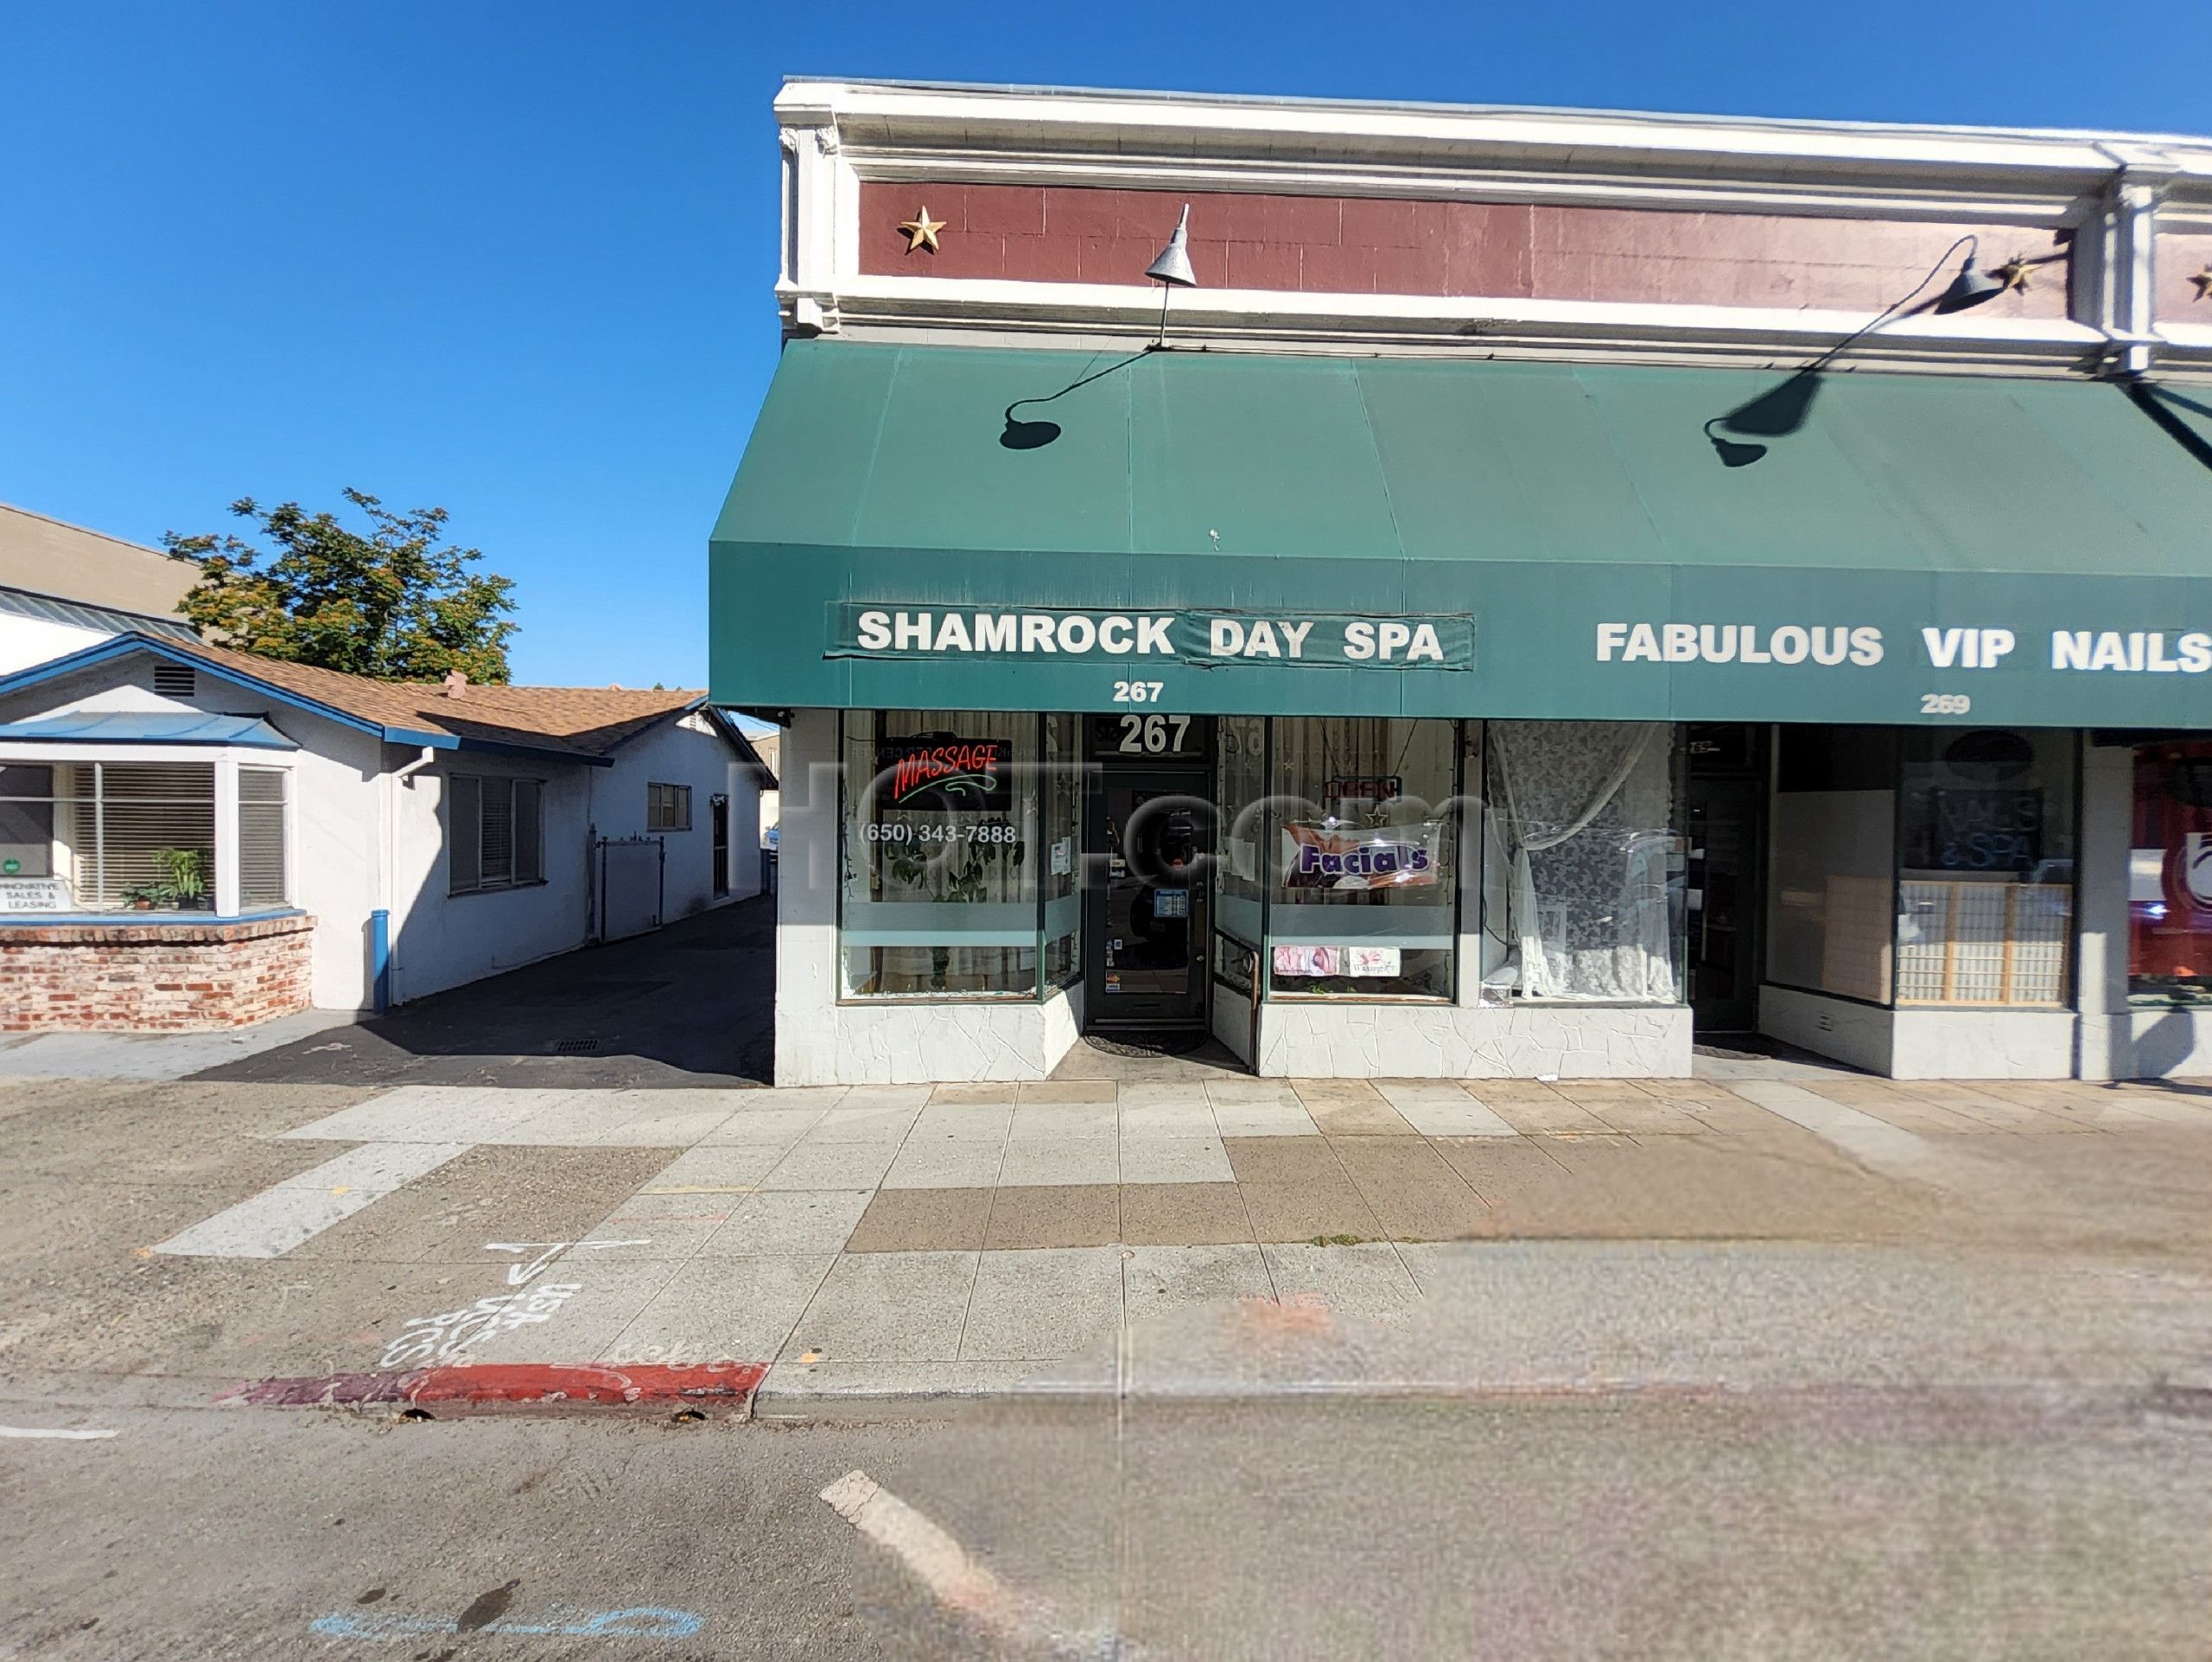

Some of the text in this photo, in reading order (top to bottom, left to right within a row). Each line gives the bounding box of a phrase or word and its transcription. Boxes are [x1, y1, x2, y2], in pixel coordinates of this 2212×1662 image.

[856, 610, 1444, 661] SHAMROCK DAY SPA
[1595, 622, 2212, 674] FABULOUS VIP NAILS
[1113, 680, 1164, 704] 267
[1920, 693, 1971, 715] 269
[1119, 714, 1191, 753] 267
[893, 743, 998, 800] MASSAGE
[859, 823, 1016, 845] (650) 343-7888
[1300, 844, 1429, 875] Facials
